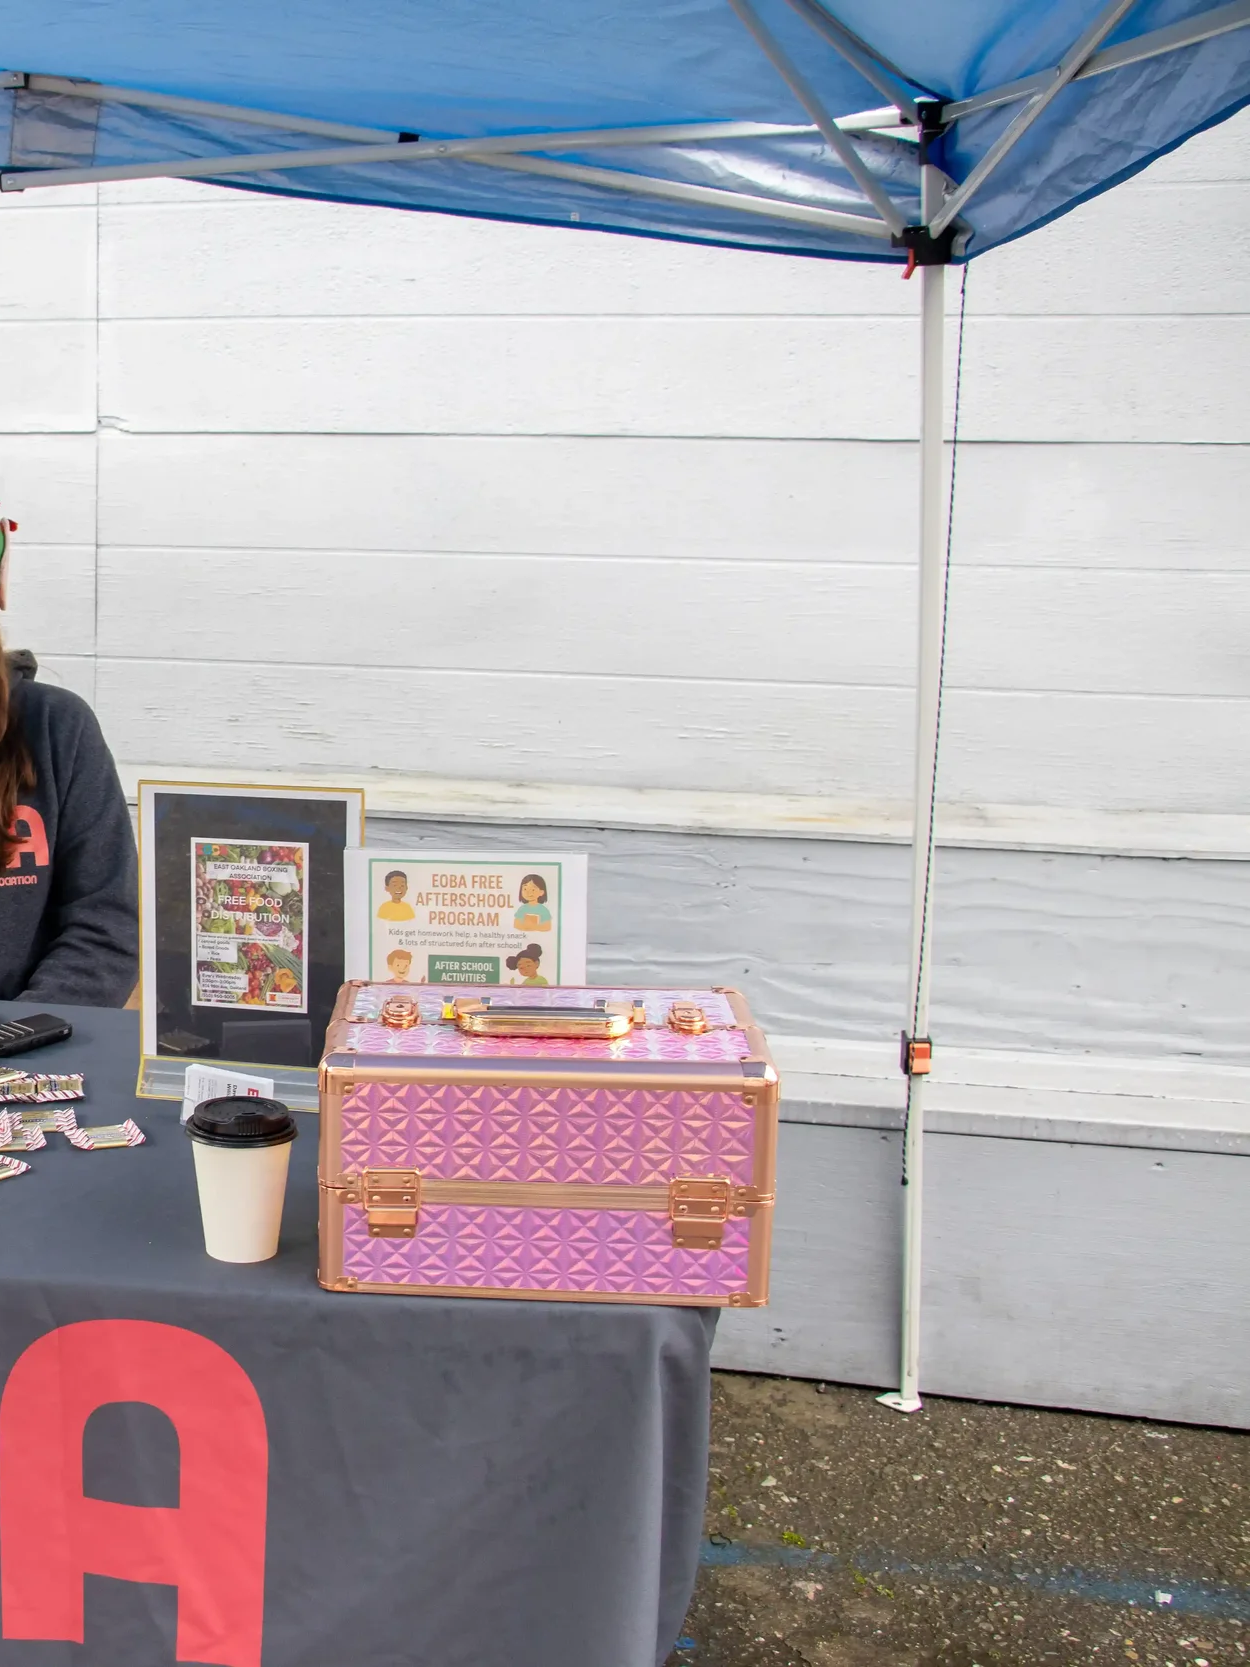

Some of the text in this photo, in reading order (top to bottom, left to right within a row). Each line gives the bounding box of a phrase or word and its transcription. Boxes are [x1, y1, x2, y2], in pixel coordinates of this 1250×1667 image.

[230, 864, 261, 872] OAKLAND
[229, 873, 272, 881] ASSOCIATION
[431, 873, 503, 890] EOBA FREE
[217, 895, 283, 908] FREE FOOD
[415, 892, 514, 909] AFTERSCHOOL
[210, 909, 290, 924] DISTRIBUTION
[428, 910, 500, 927] PROGRAM
[388, 928, 404, 936] Kids
[405, 929, 416, 938] get
[417, 929, 454, 938] homework
[479, 930, 505, 940] healthy
[506, 931, 527, 940] snack
[419, 939, 427, 947] of
[428, 939, 464, 948] structured
[465, 940, 476, 948] fun
[478, 940, 495, 949] after
[496, 941, 523, 949] school!
[434, 961, 494, 972] AFTER SCHOOL
[441, 972, 487, 983] ACTIVITIES
